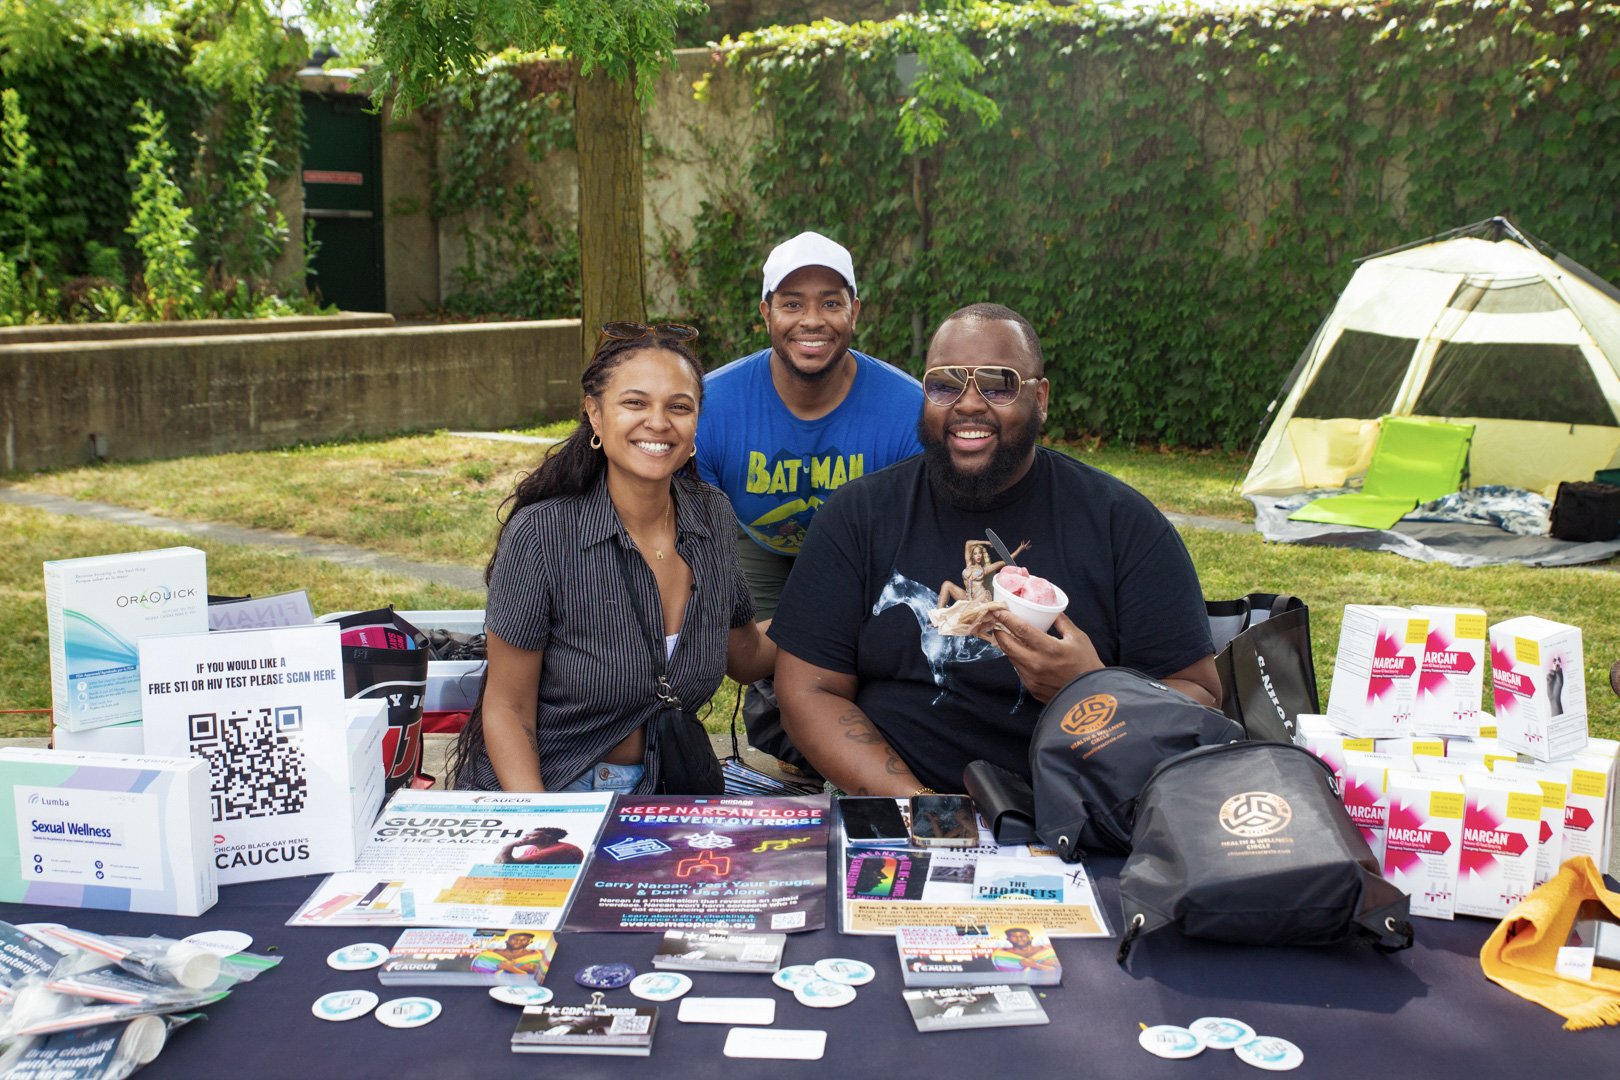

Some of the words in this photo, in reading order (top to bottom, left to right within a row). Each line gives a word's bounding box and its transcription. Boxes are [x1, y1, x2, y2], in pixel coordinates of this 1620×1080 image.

[1373, 657, 1405, 669] NARCAN
[1424, 651, 1458, 665] ARCAN
[196, 663, 205, 674] IF
[207, 661, 224, 673] YOU
[226, 659, 257, 671] WOULD
[259, 657, 278, 669] LIKE
[280, 657, 286, 667] A
[148, 682, 172, 695] FREE
[174, 680, 189, 692] STI
[191, 679, 205, 691] OR
[207, 678, 223, 690] HIV
[225, 676, 247, 689] TEST
[250, 673, 284, 687] PLEASE
[286, 670, 311, 684] SCAN
[313, 669, 336, 682] HERE
[1493, 668, 1521, 687] NARCAN
[42, 797, 70, 806] Lumba
[620, 806, 669, 815] KEEP
[675, 806, 754, 817] NARCAN
[758, 809, 822, 817] CLOSE
[1344, 804, 1385, 820] NARCAN
[384, 817, 503, 828] GUIDED
[618, 814, 640, 822] TO
[643, 815, 726, 825] PREVENT
[726, 817, 822, 826] OVERDOSE
[31, 820, 65, 834] Sexual
[67, 821, 112, 838] Wellness
[376, 827, 523, 838] GROWTH
[1388, 827, 1432, 845] NARCAN
[1463, 827, 1508, 846] NARCAN
[214, 844, 246, 853] CHICAGO
[248, 841, 271, 849] BLACK
[215, 844, 310, 869] CAUCUS
[594, 881, 634, 889] Carry
[723, 888, 769, 896] Alone.
[979, 886, 1057, 899] PROPHETS
[771, 895, 799, 903] opioid
[3, 943, 54, 972] checking
[394, 963, 438, 971] CAUCUS
[920, 964, 963, 972] CAUCUS
[25, 1048, 59, 1059] Drug
[59, 1038, 116, 1057] checking
